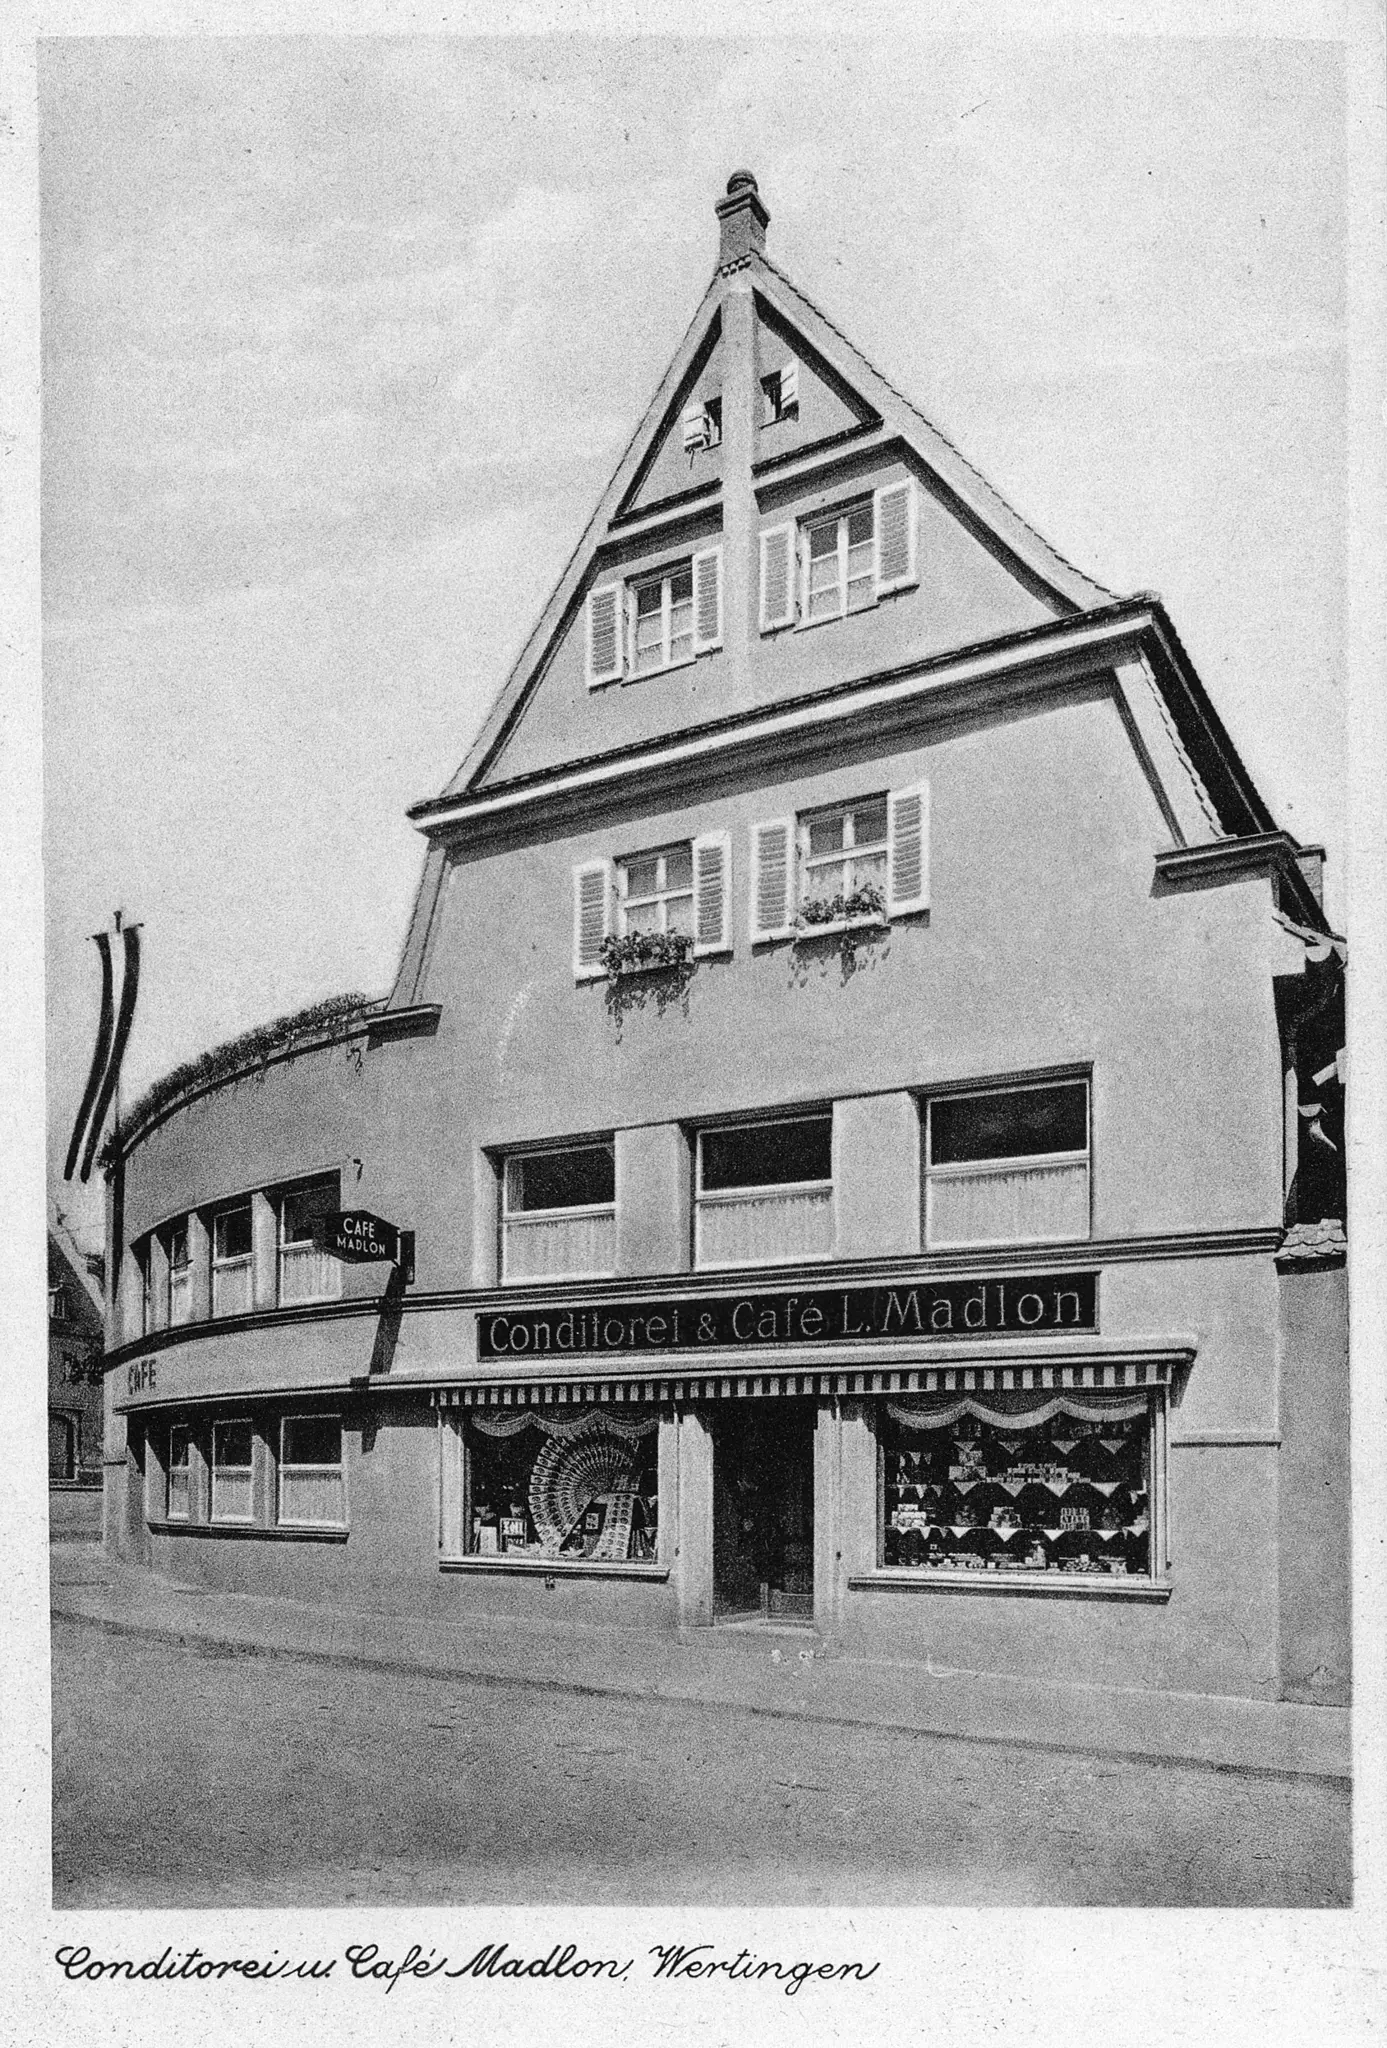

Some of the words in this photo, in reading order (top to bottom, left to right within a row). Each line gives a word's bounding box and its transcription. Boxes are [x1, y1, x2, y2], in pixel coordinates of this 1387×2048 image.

[336, 1235, 386, 1255] MADLON
[489, 1308, 681, 1352] Conditorei
[696, 1312, 717, 1342] &
[731, 1297, 824, 1341] Café
